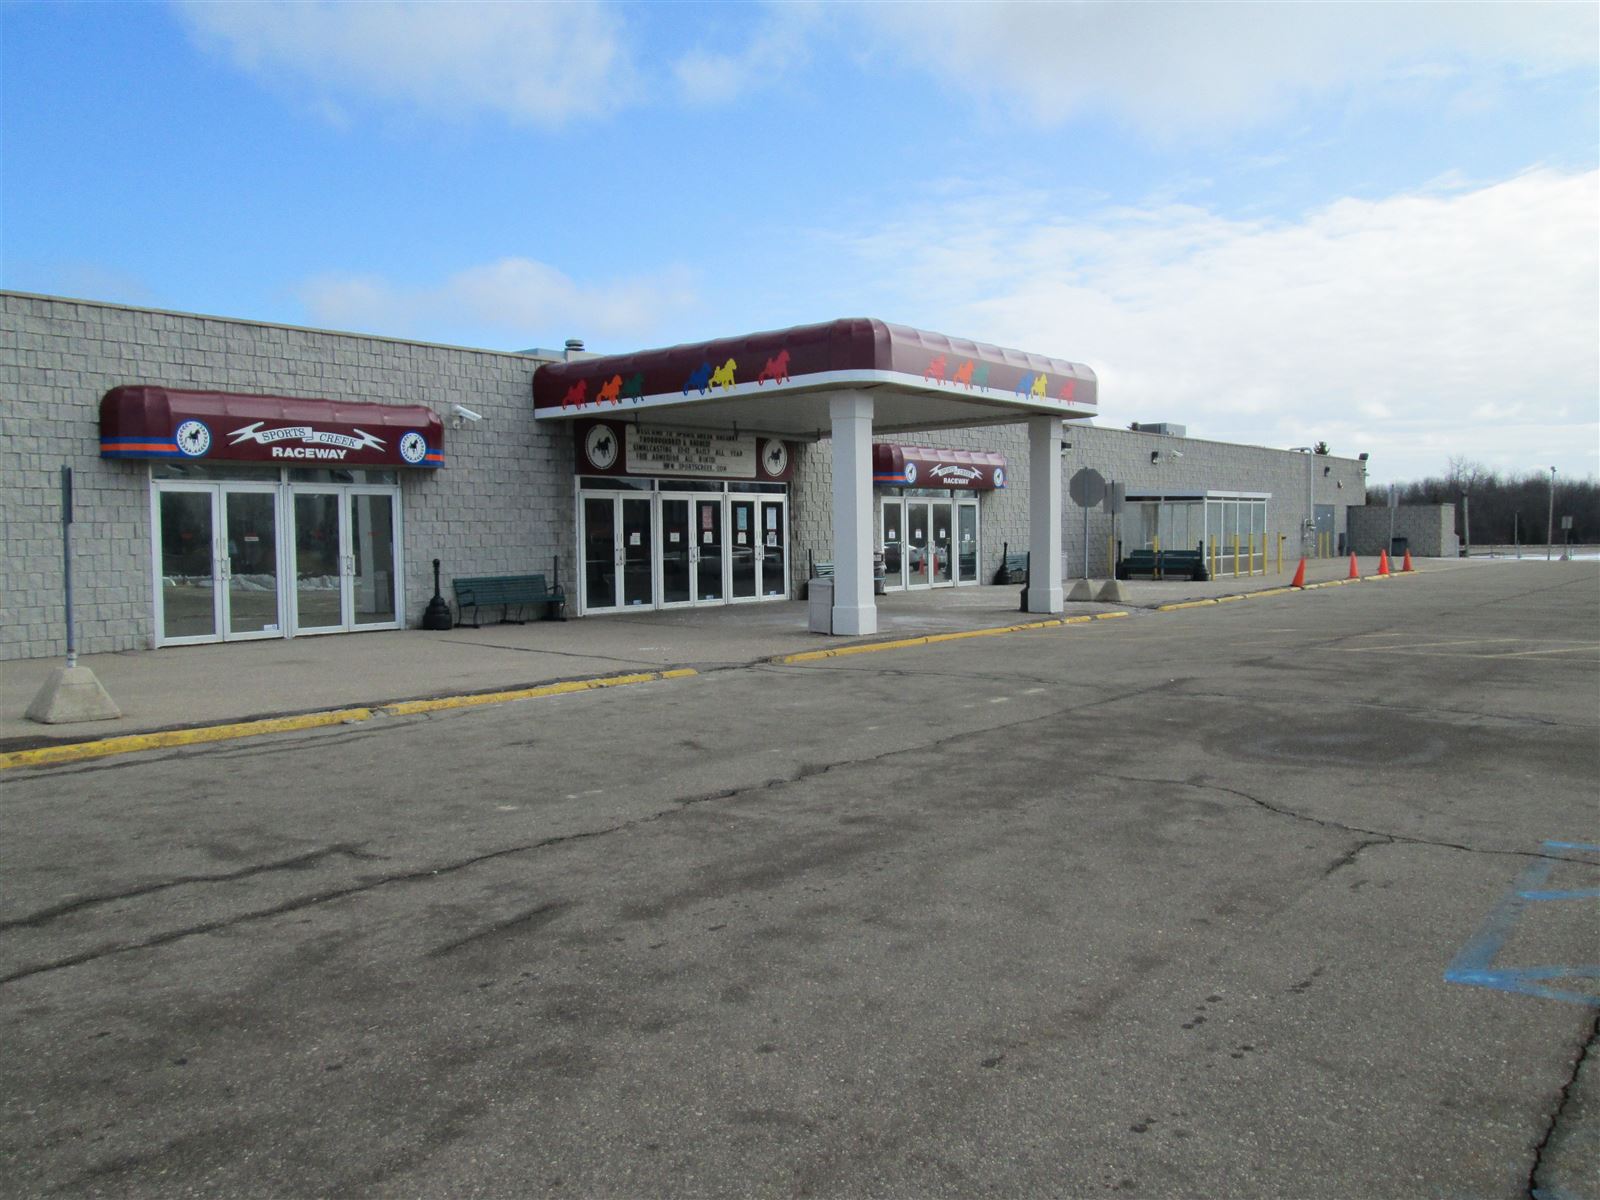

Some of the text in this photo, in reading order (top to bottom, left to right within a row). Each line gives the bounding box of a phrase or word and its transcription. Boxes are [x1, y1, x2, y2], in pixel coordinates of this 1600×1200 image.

[261, 427, 357, 447] SPORTS CREEK
[272, 447, 347, 459] RACEWAY
